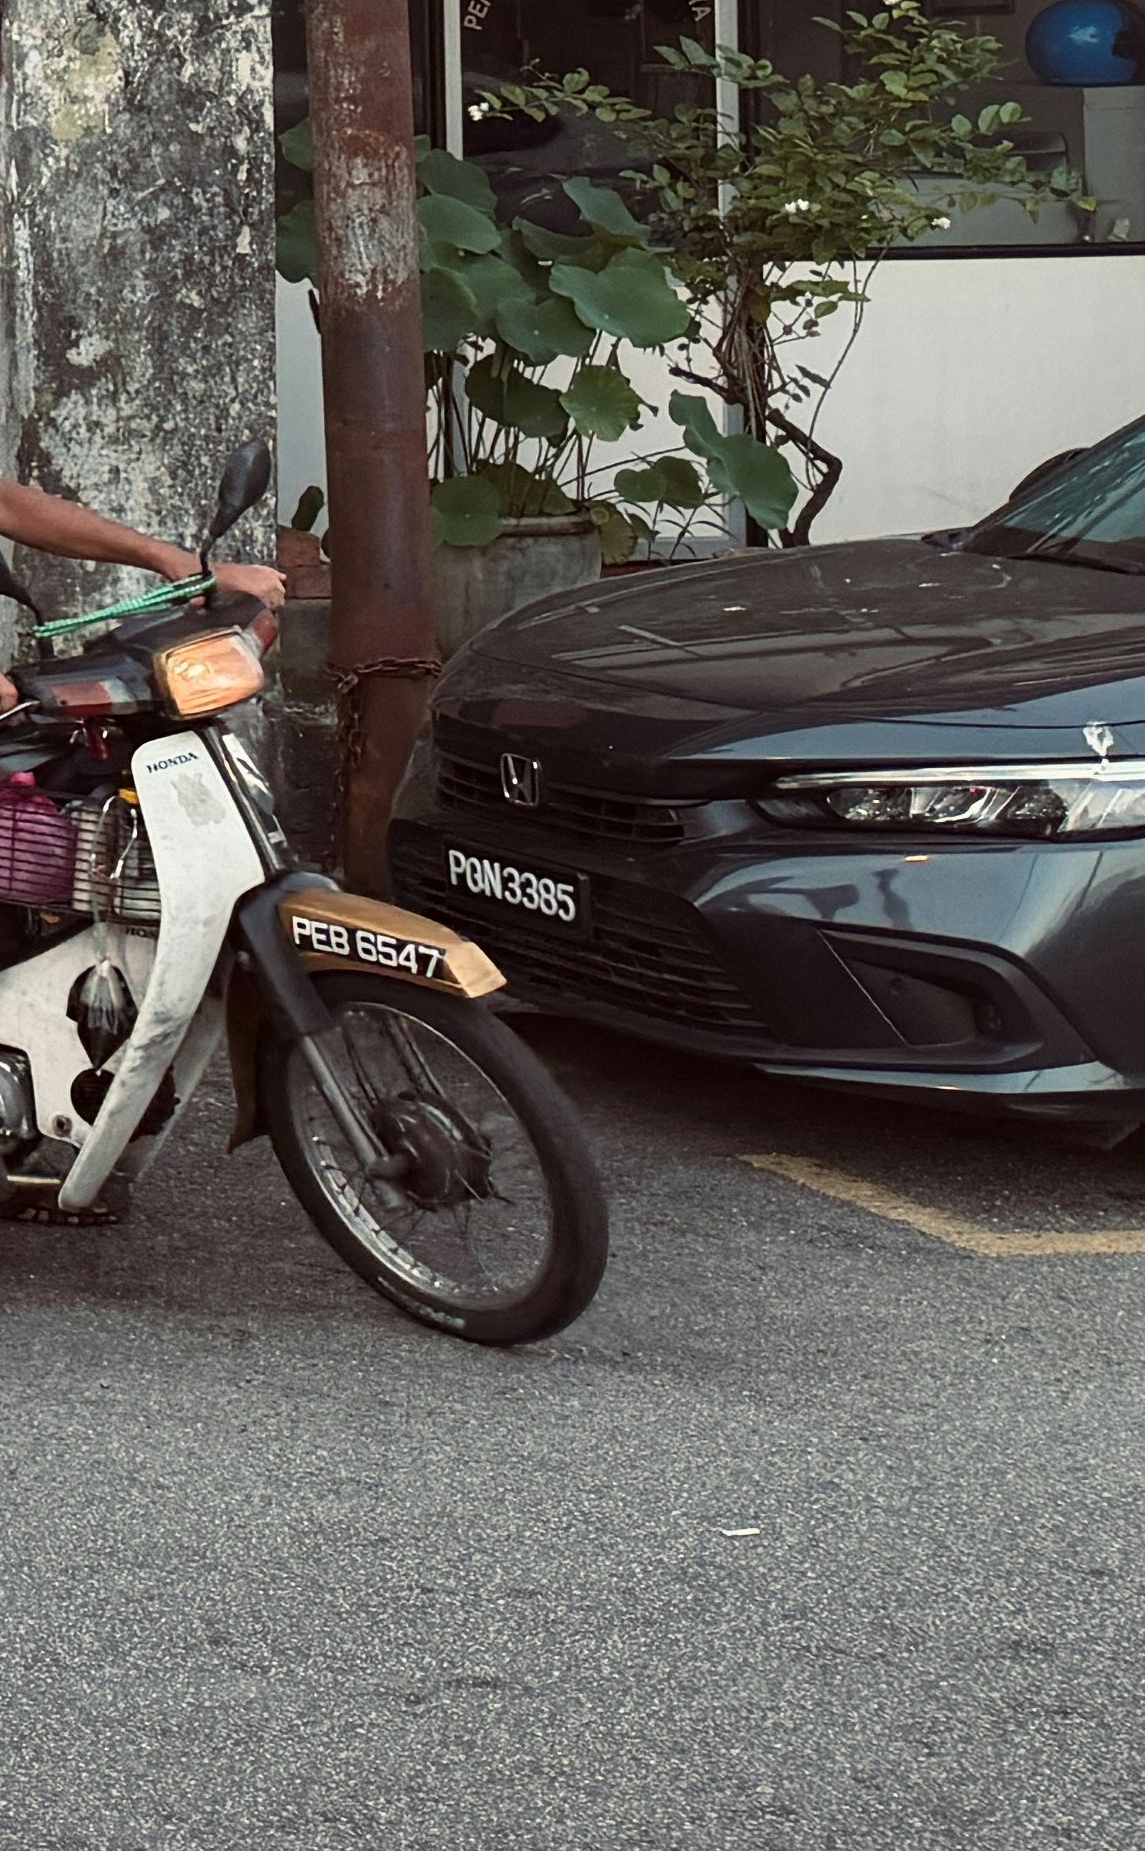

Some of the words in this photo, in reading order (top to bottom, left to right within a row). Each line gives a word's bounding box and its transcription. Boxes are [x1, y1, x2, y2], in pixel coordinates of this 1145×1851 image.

[147, 752, 198, 773] HONDA
[292, 915, 351, 956] PEB
[355, 930, 447, 978] 6547
